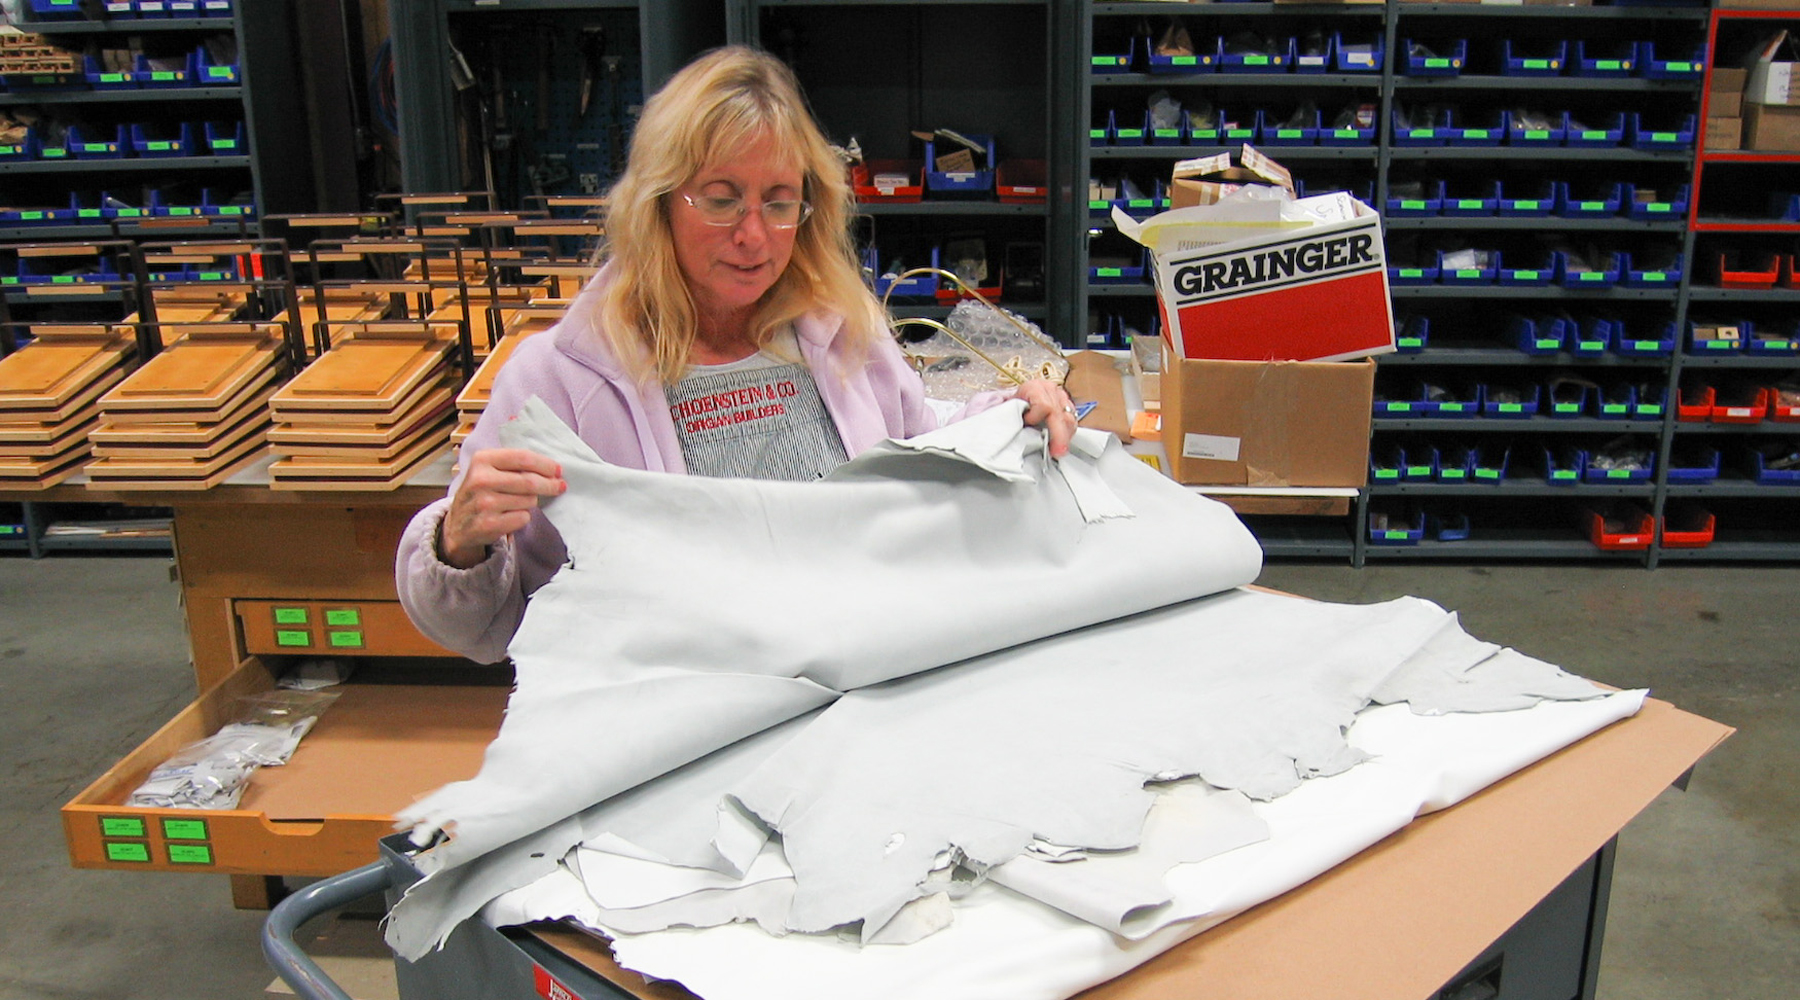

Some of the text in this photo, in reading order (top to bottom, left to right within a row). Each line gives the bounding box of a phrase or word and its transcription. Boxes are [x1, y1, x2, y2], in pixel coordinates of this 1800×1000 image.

[1174, 234, 1373, 296] GRAINGER
[765, 384, 776, 400] &
[777, 381, 800, 398] CO.
[686, 404, 785, 433] ORGAN BUILDERS
